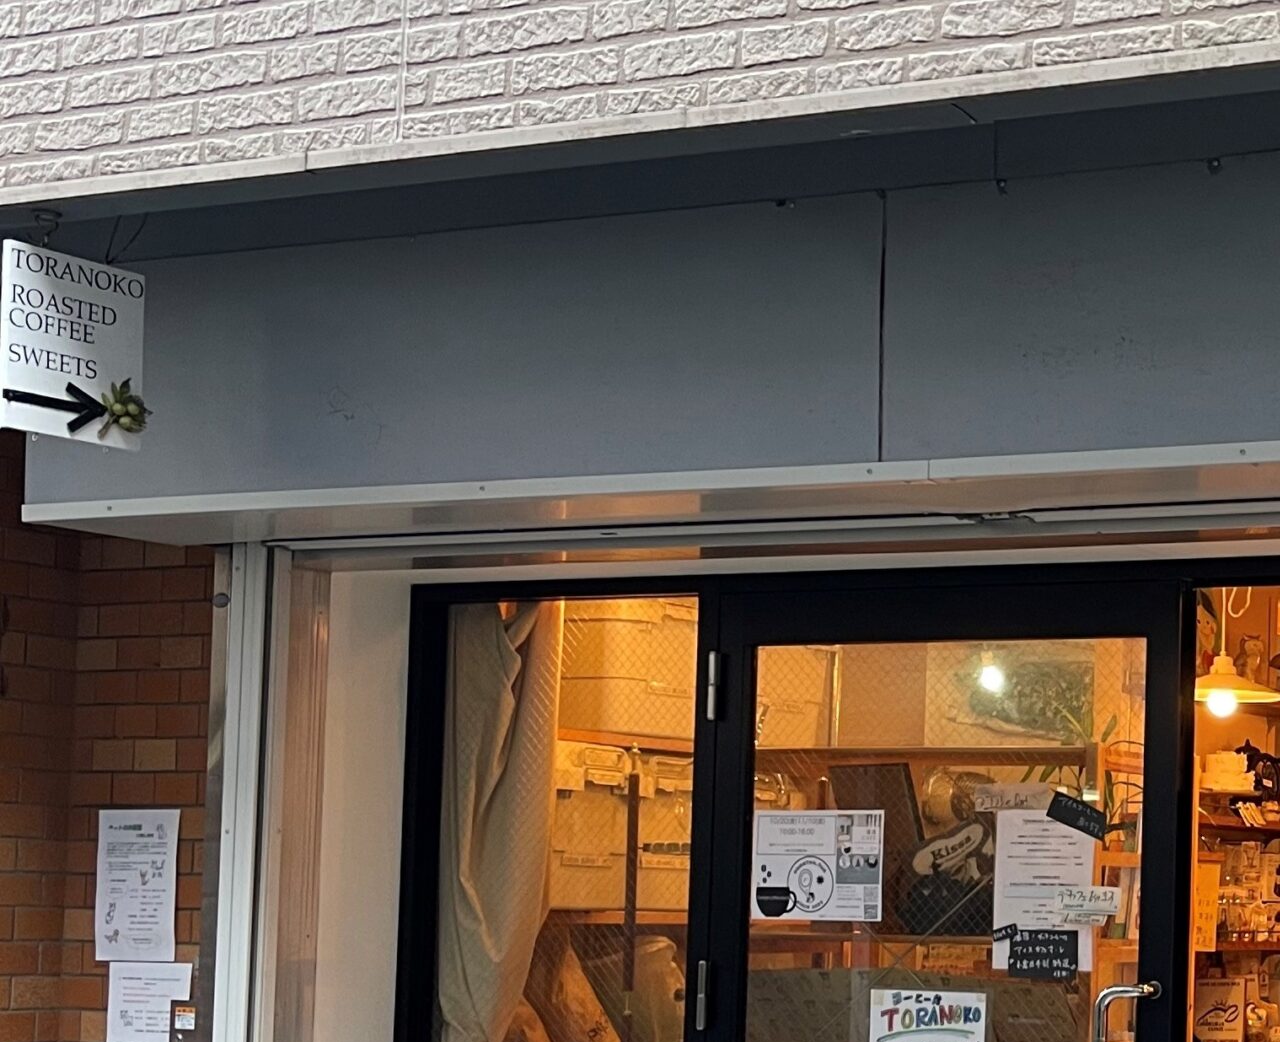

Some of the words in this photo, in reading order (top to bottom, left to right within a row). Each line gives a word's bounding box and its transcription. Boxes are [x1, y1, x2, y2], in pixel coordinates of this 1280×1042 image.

[11, 248, 145, 299] TORANOKO
[11, 283, 117, 326] ROASTED
[8, 307, 96, 345] COFFEE
[8, 343, 98, 380] SWEETS
[929, 834, 973, 861] Kissa
[880, 1004, 982, 1032] TORANOKO
